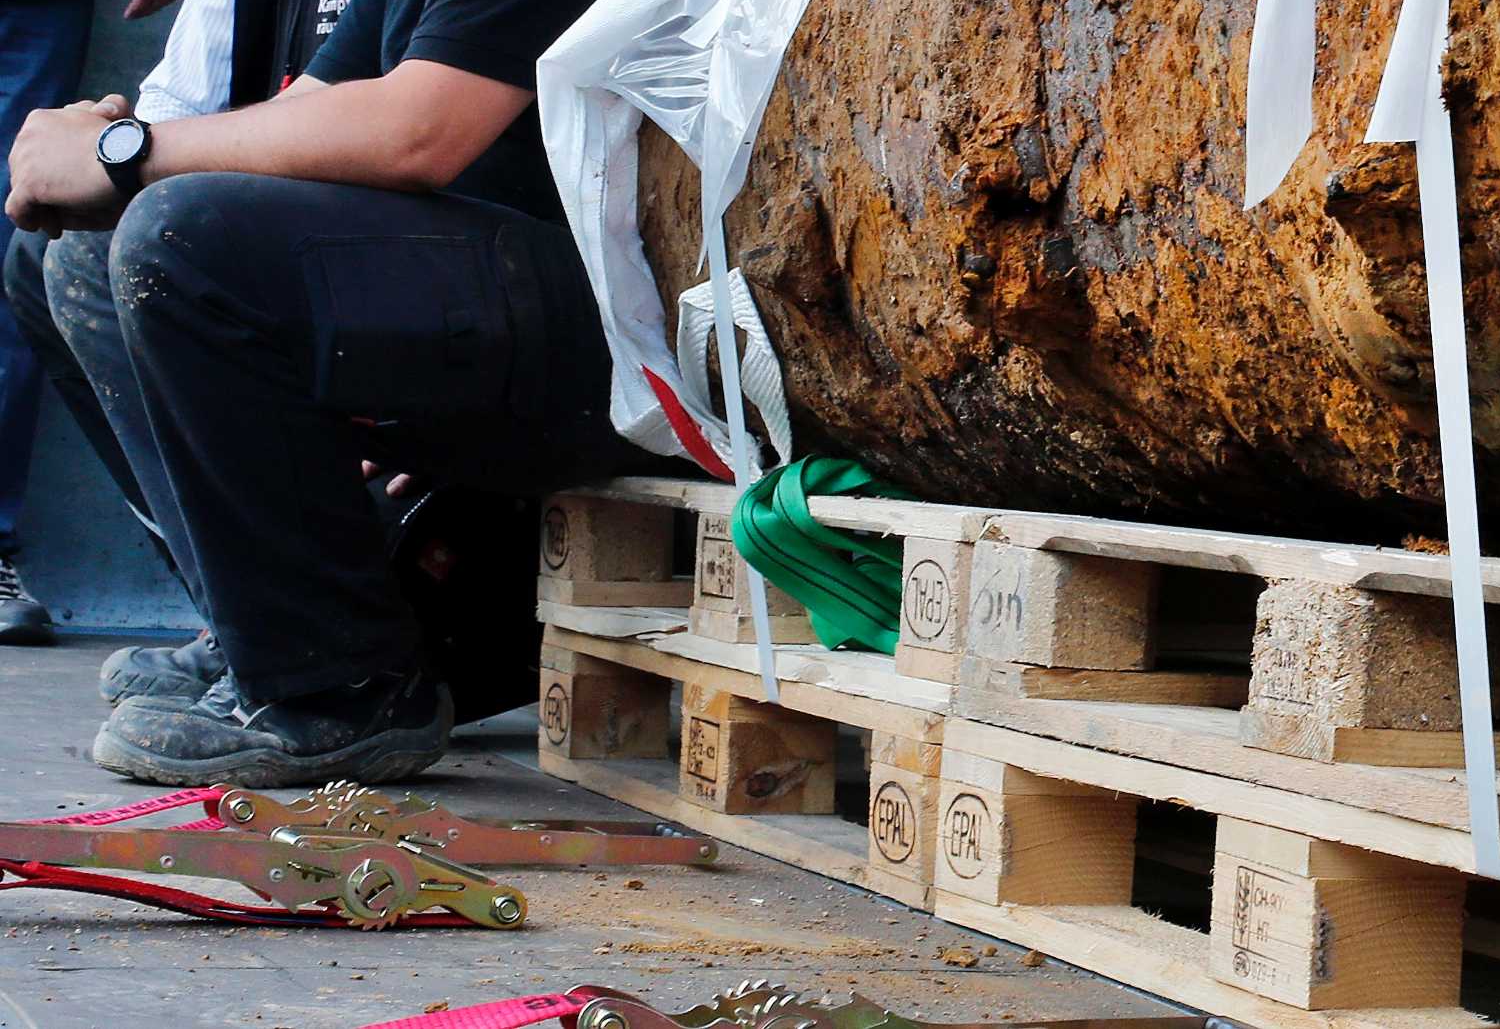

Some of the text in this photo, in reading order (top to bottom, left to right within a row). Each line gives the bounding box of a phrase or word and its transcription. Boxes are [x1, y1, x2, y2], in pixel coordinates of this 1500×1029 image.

[911, 576, 944, 625] EPAL
[877, 796, 911, 849] EPAL
[949, 813, 983, 867] EPAL
